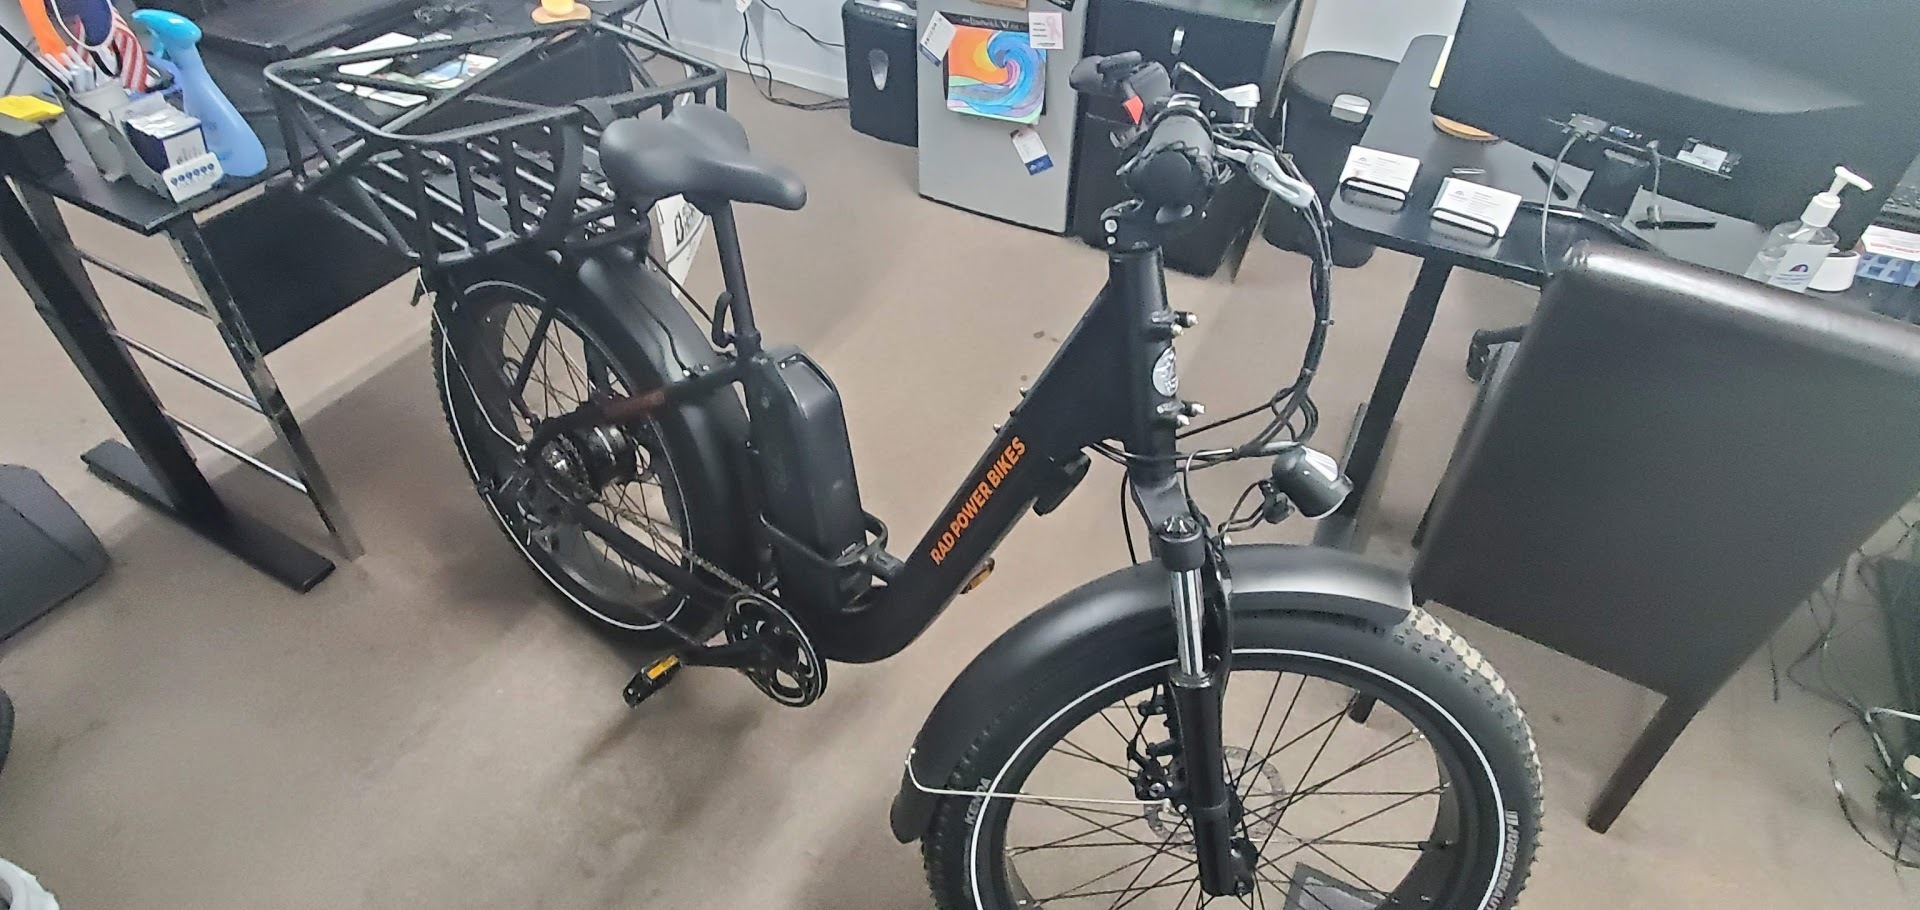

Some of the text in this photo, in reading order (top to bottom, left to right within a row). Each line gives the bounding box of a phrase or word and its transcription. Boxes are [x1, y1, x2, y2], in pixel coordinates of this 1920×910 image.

[930, 436, 1026, 566] RAD POWER BIKES
